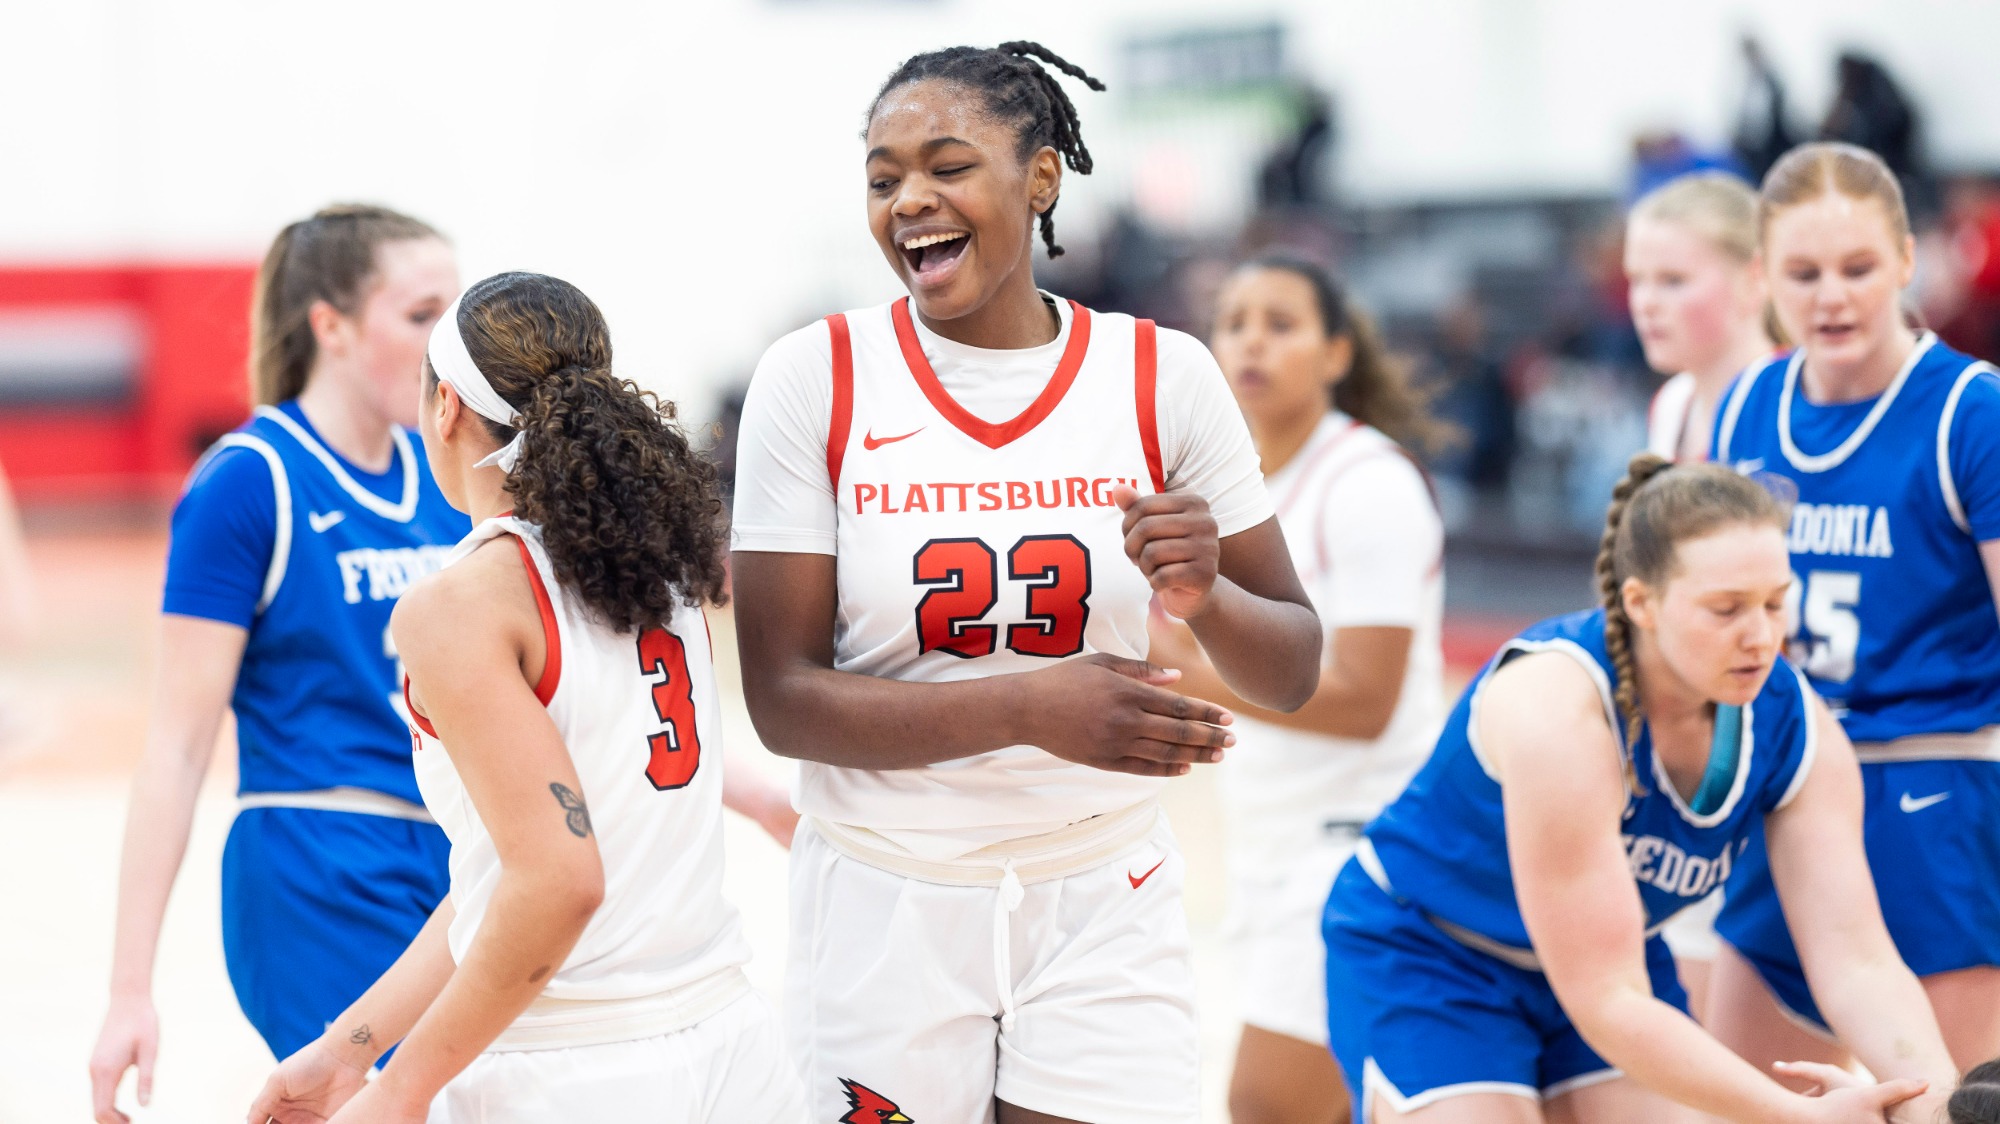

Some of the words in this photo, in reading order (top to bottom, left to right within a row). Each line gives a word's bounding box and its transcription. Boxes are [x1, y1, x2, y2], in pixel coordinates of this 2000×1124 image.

[854, 476, 1137, 515] PLATTSBURG
[1785, 503, 1894, 558] DONIA
[913, 533, 1092, 659] 23
[636, 625, 701, 791] 3
